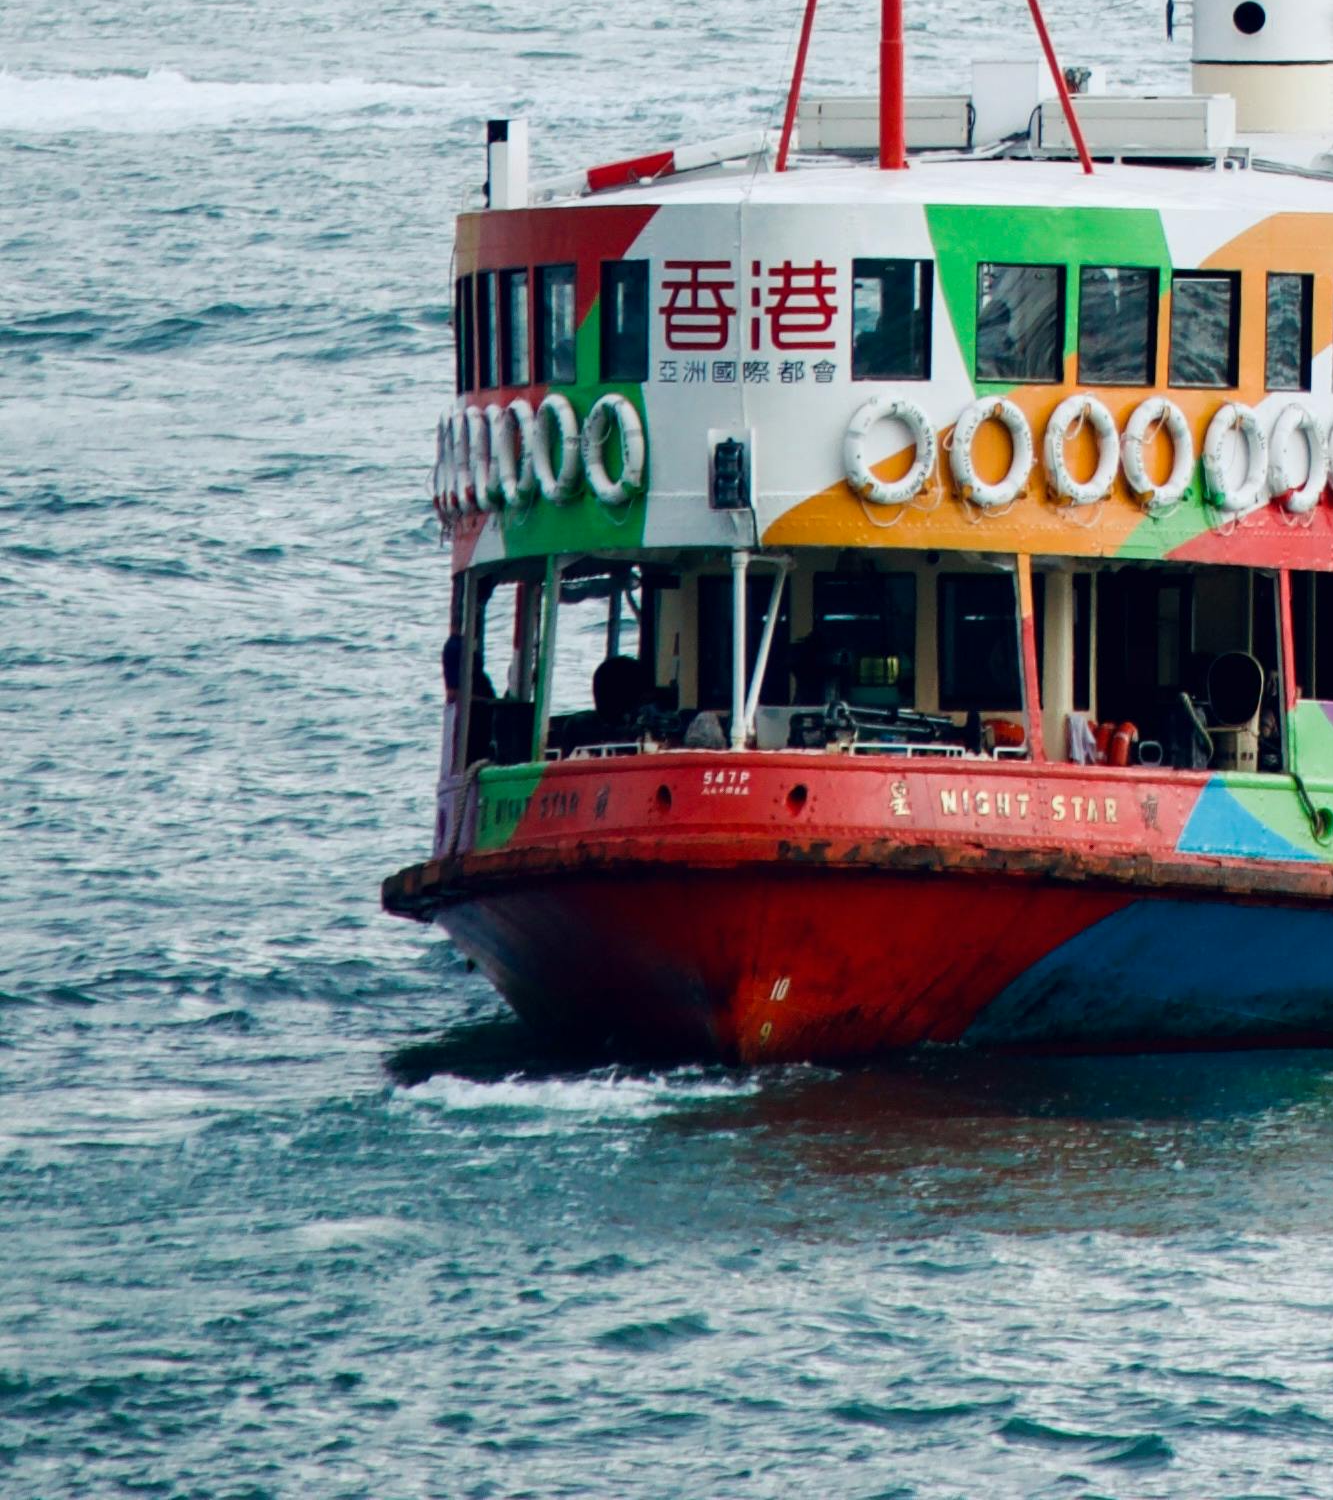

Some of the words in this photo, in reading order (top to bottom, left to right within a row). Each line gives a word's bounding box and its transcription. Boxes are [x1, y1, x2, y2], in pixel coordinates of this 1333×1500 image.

[658, 259, 839, 351] 香港
[657, 359, 838, 385] 亞洲國際都會
[703, 770, 750, 785] 547P
[940, 789, 1030, 818] NIGHT
[1051, 795, 1118, 823] STAR
[769, 976, 791, 1001] 10
